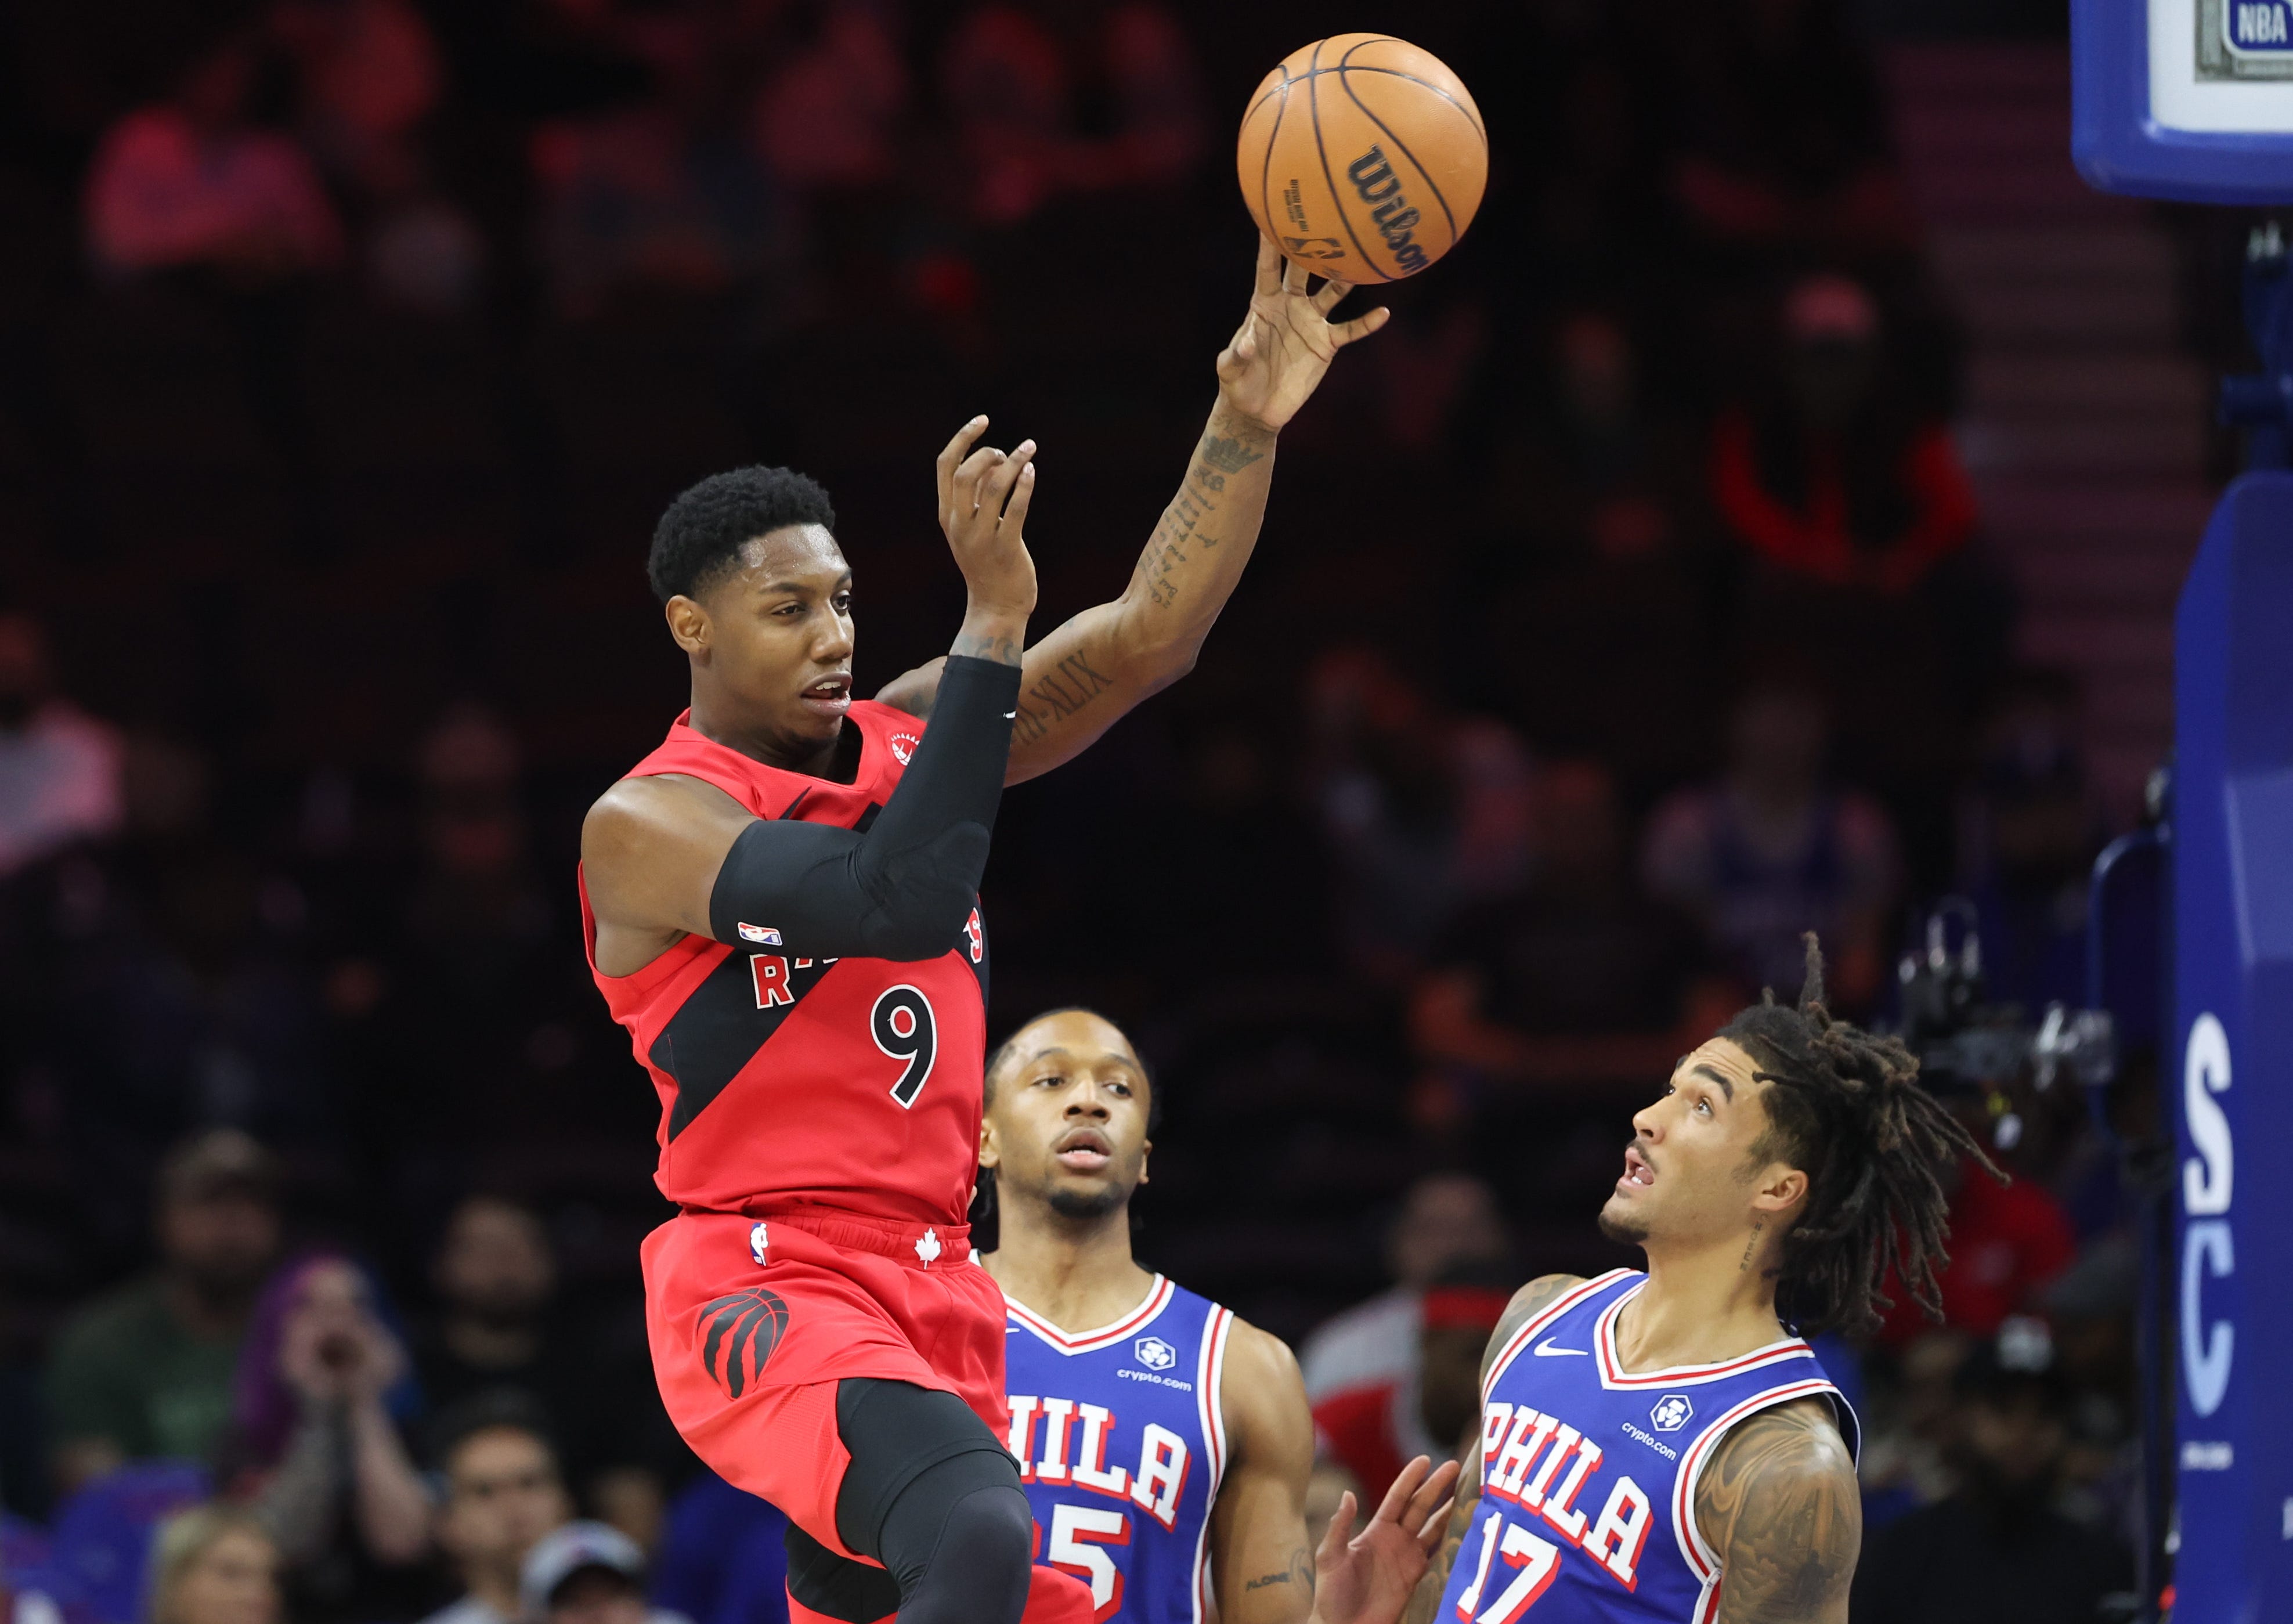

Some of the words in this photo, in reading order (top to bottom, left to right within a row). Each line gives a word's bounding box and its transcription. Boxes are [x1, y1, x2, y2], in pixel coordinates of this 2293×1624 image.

[2237, 2, 2288, 44] NBA
[1348, 144, 1429, 275] Wilson
[870, 983, 937, 1110] 9
[1117, 1367, 1192, 1392] crypto.com
[1006, 1394, 1191, 1533] HILA
[1480, 1402, 1653, 1593] PHILA
[1621, 1421, 1677, 1461] crypto.com
[1032, 1503, 1131, 1623] 5
[1456, 1511, 1561, 1623] 17
